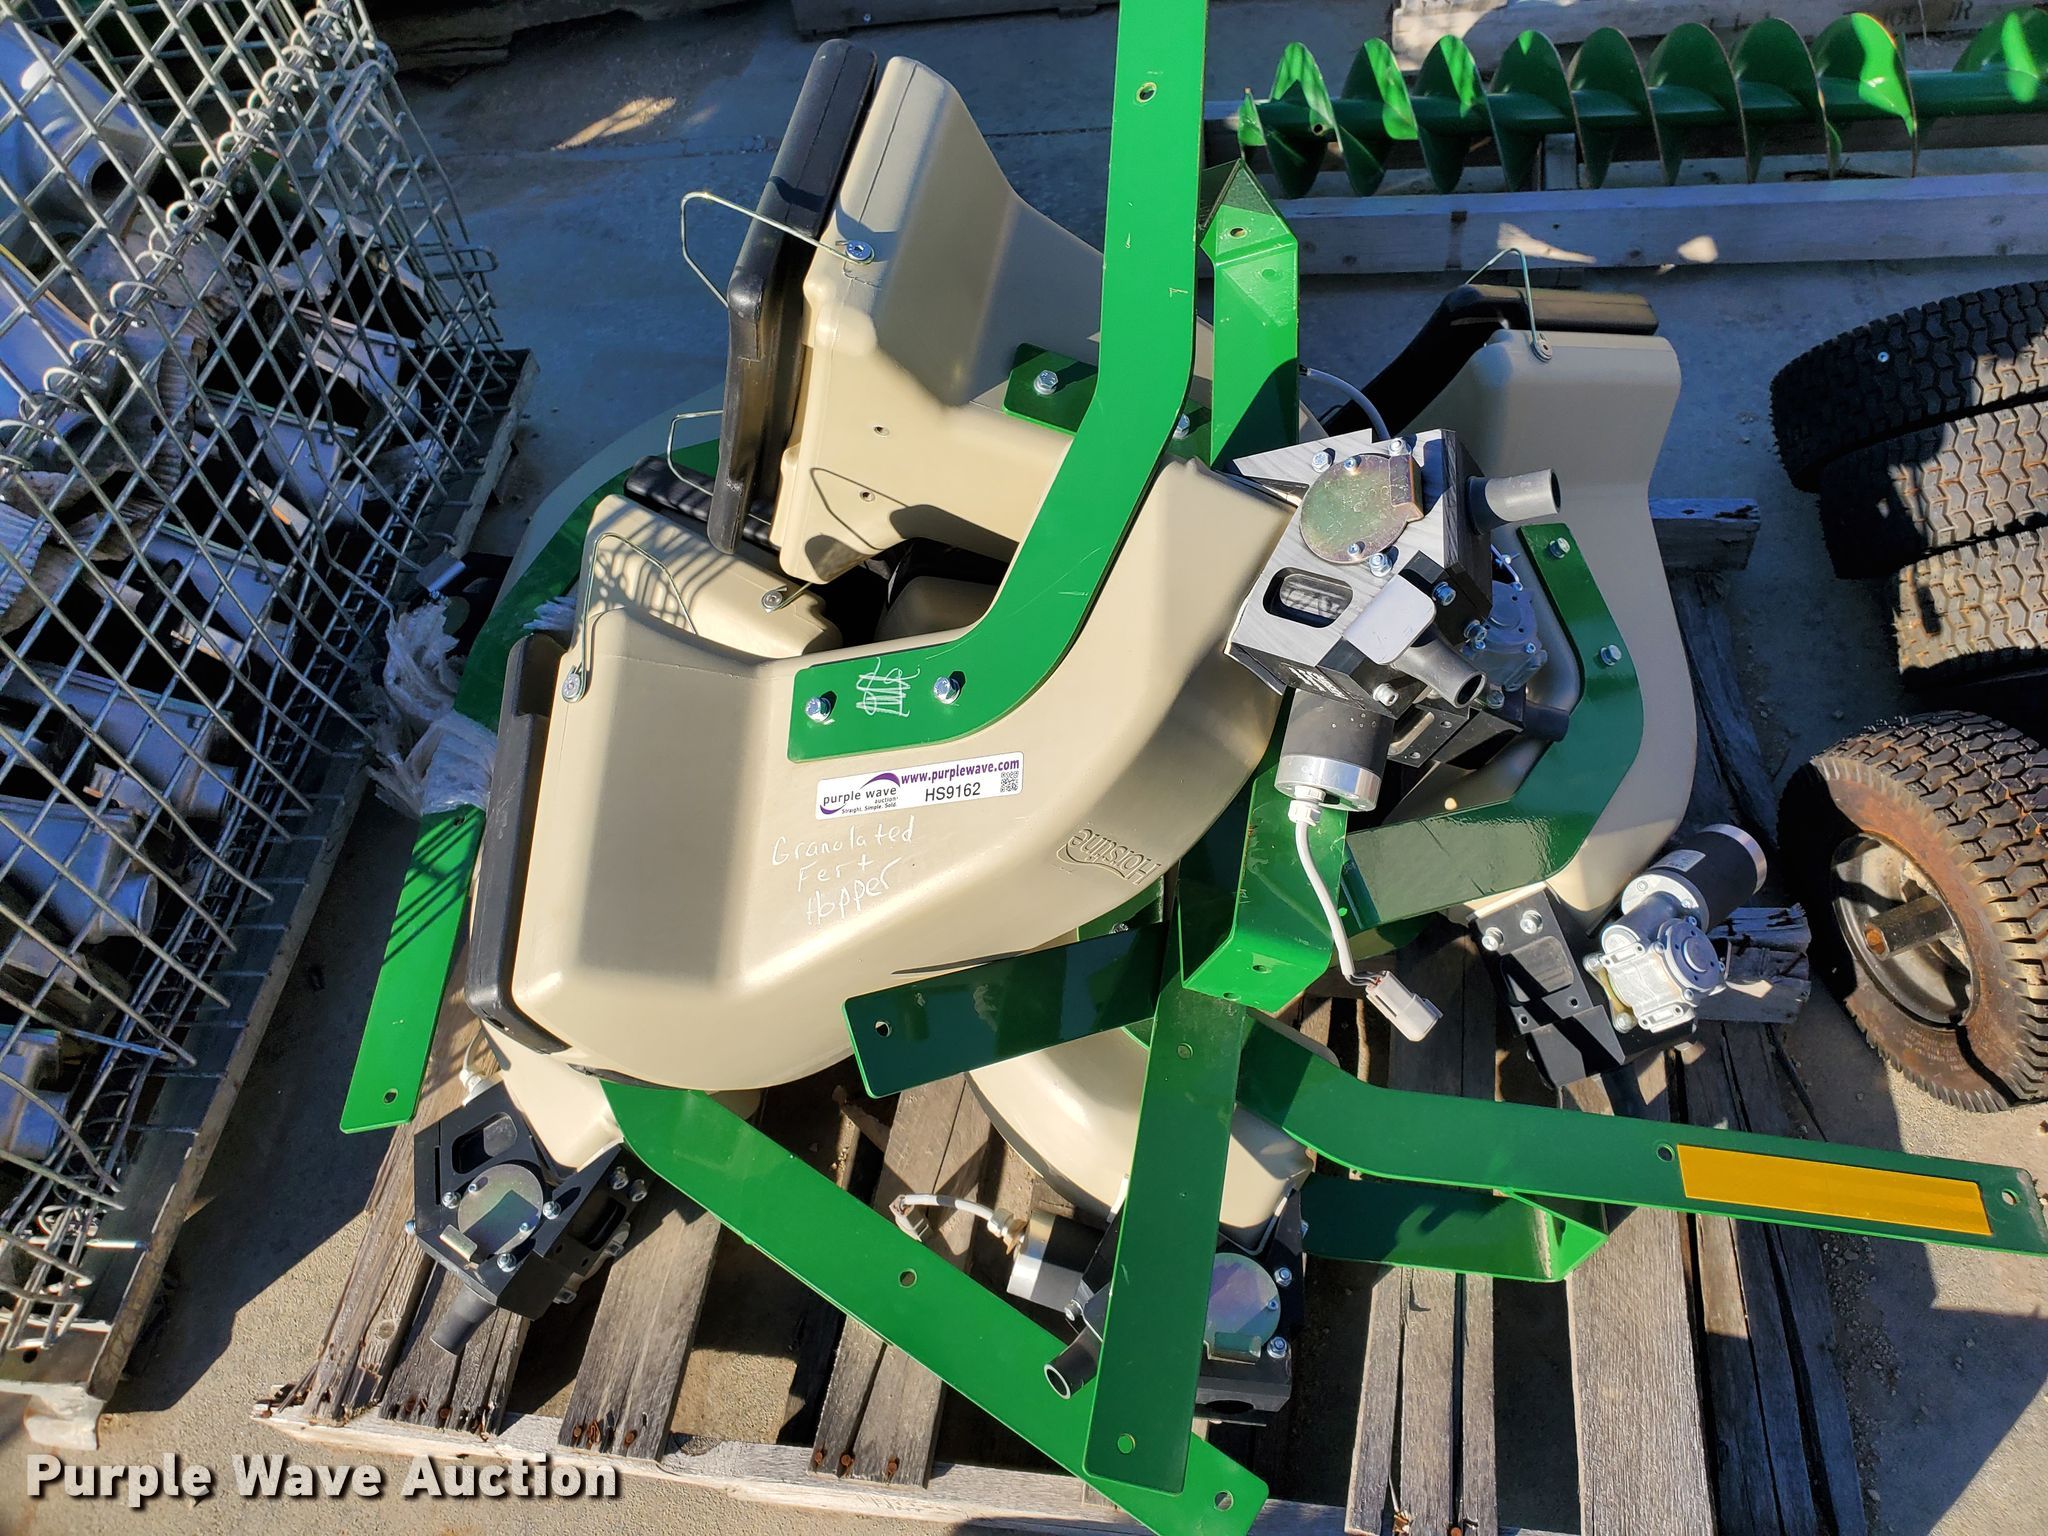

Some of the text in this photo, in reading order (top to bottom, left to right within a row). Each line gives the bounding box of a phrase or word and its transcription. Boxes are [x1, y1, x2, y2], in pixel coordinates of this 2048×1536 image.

[901, 758, 1020, 784] www.purplewave.com
[823, 787, 897, 806] purple wave
[925, 782, 981, 802] HS9162
[806, 856, 902, 925] Hopper
